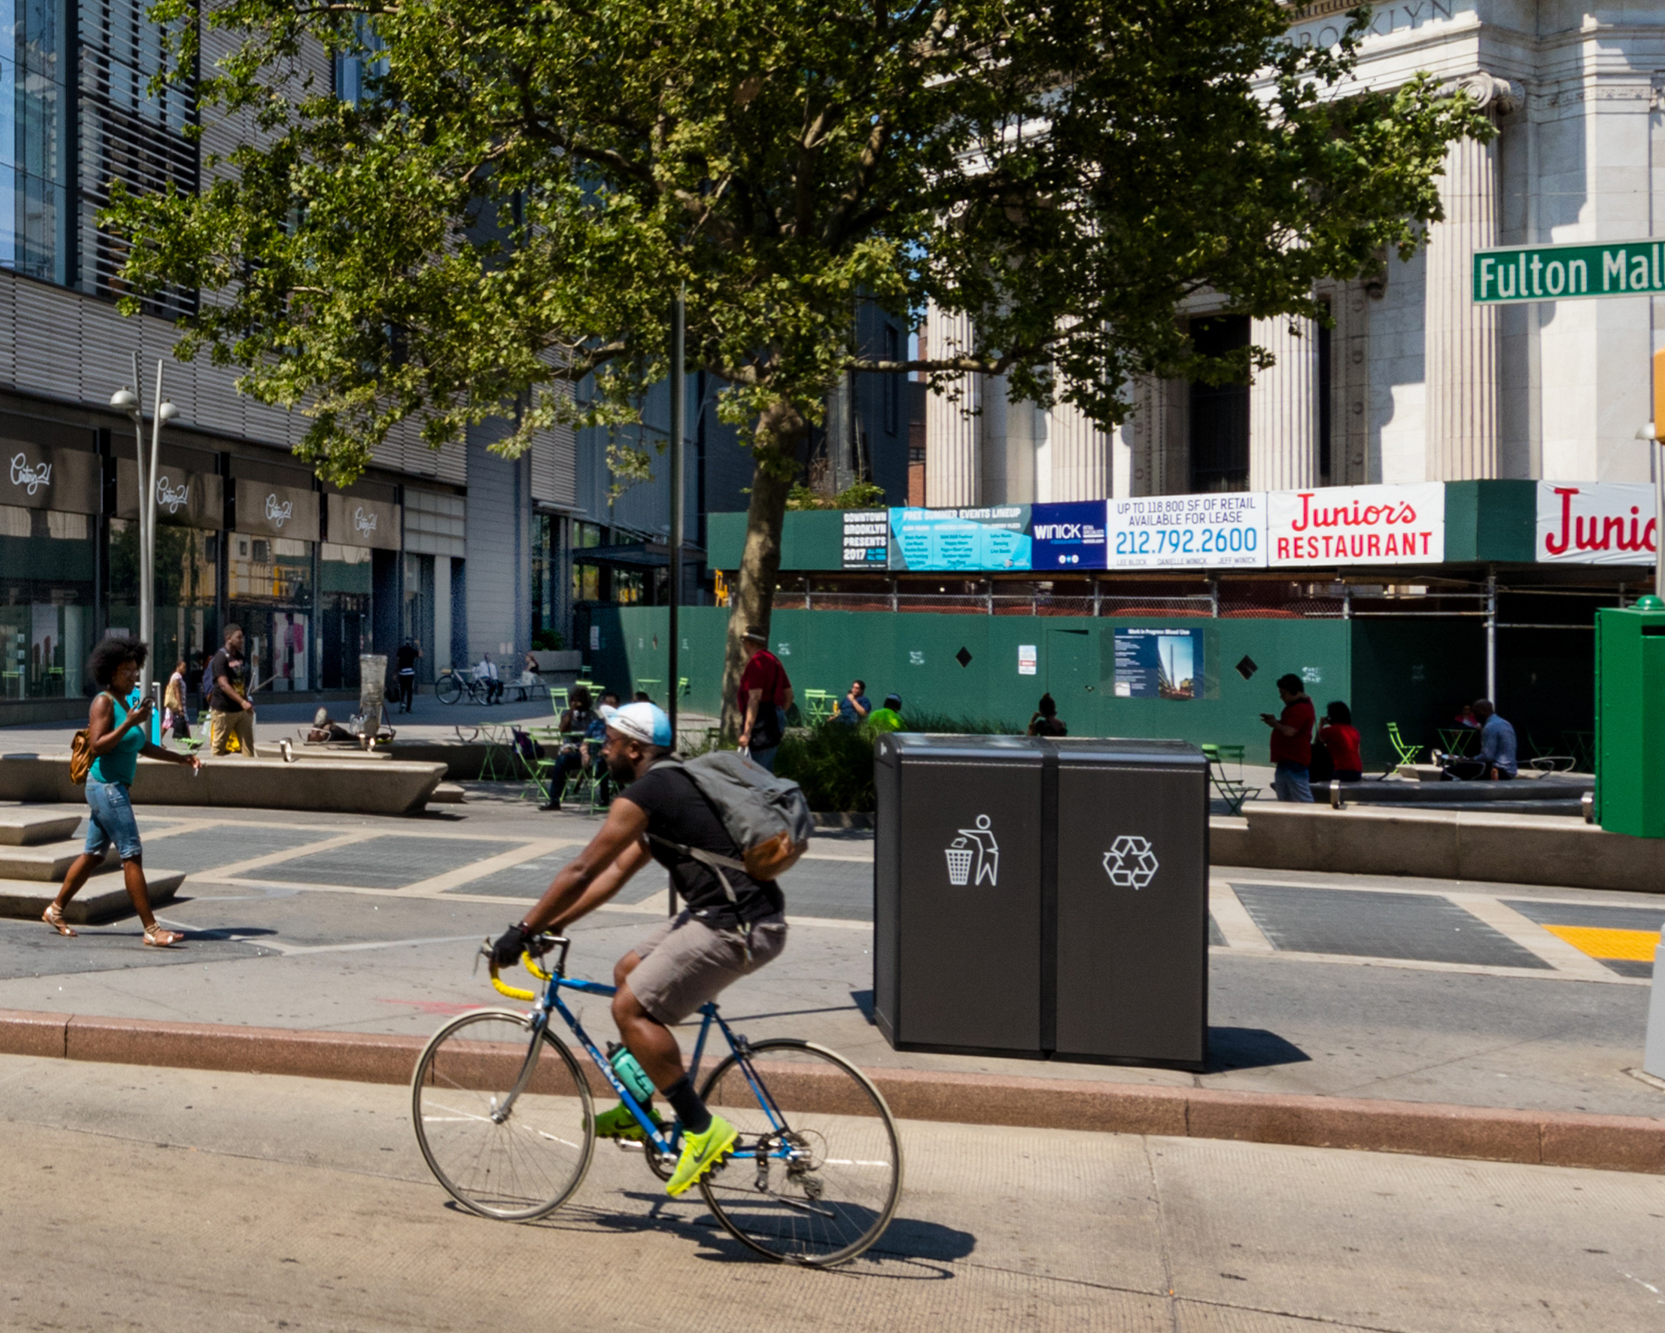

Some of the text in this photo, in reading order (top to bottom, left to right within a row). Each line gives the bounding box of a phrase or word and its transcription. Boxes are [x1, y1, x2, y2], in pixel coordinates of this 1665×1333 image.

[1480, 243, 1665, 299] Fulton Mal
[1117, 502, 1131, 514] UP
[1133, 501, 1145, 514] TO
[1187, 499, 1201, 512] SF
[1203, 498, 1217, 511] OF
[1220, 497, 1256, 510] RETAIL
[1292, 493, 1417, 532] Junior's
[843, 512, 887, 523] DOWNTOWN
[903, 507, 1021, 521] FREE SUMMER EVENTS LINEUP
[1129, 510, 1243, 526] AVAILABLE FOR LEASE
[843, 524, 887, 535] BROOKLYN
[843, 536, 887, 547] PRESENTS
[1116, 527, 1257, 554] 212.792.2600
[1277, 531, 1433, 559] RESTAURANT
[843, 548, 866, 560] 2017
